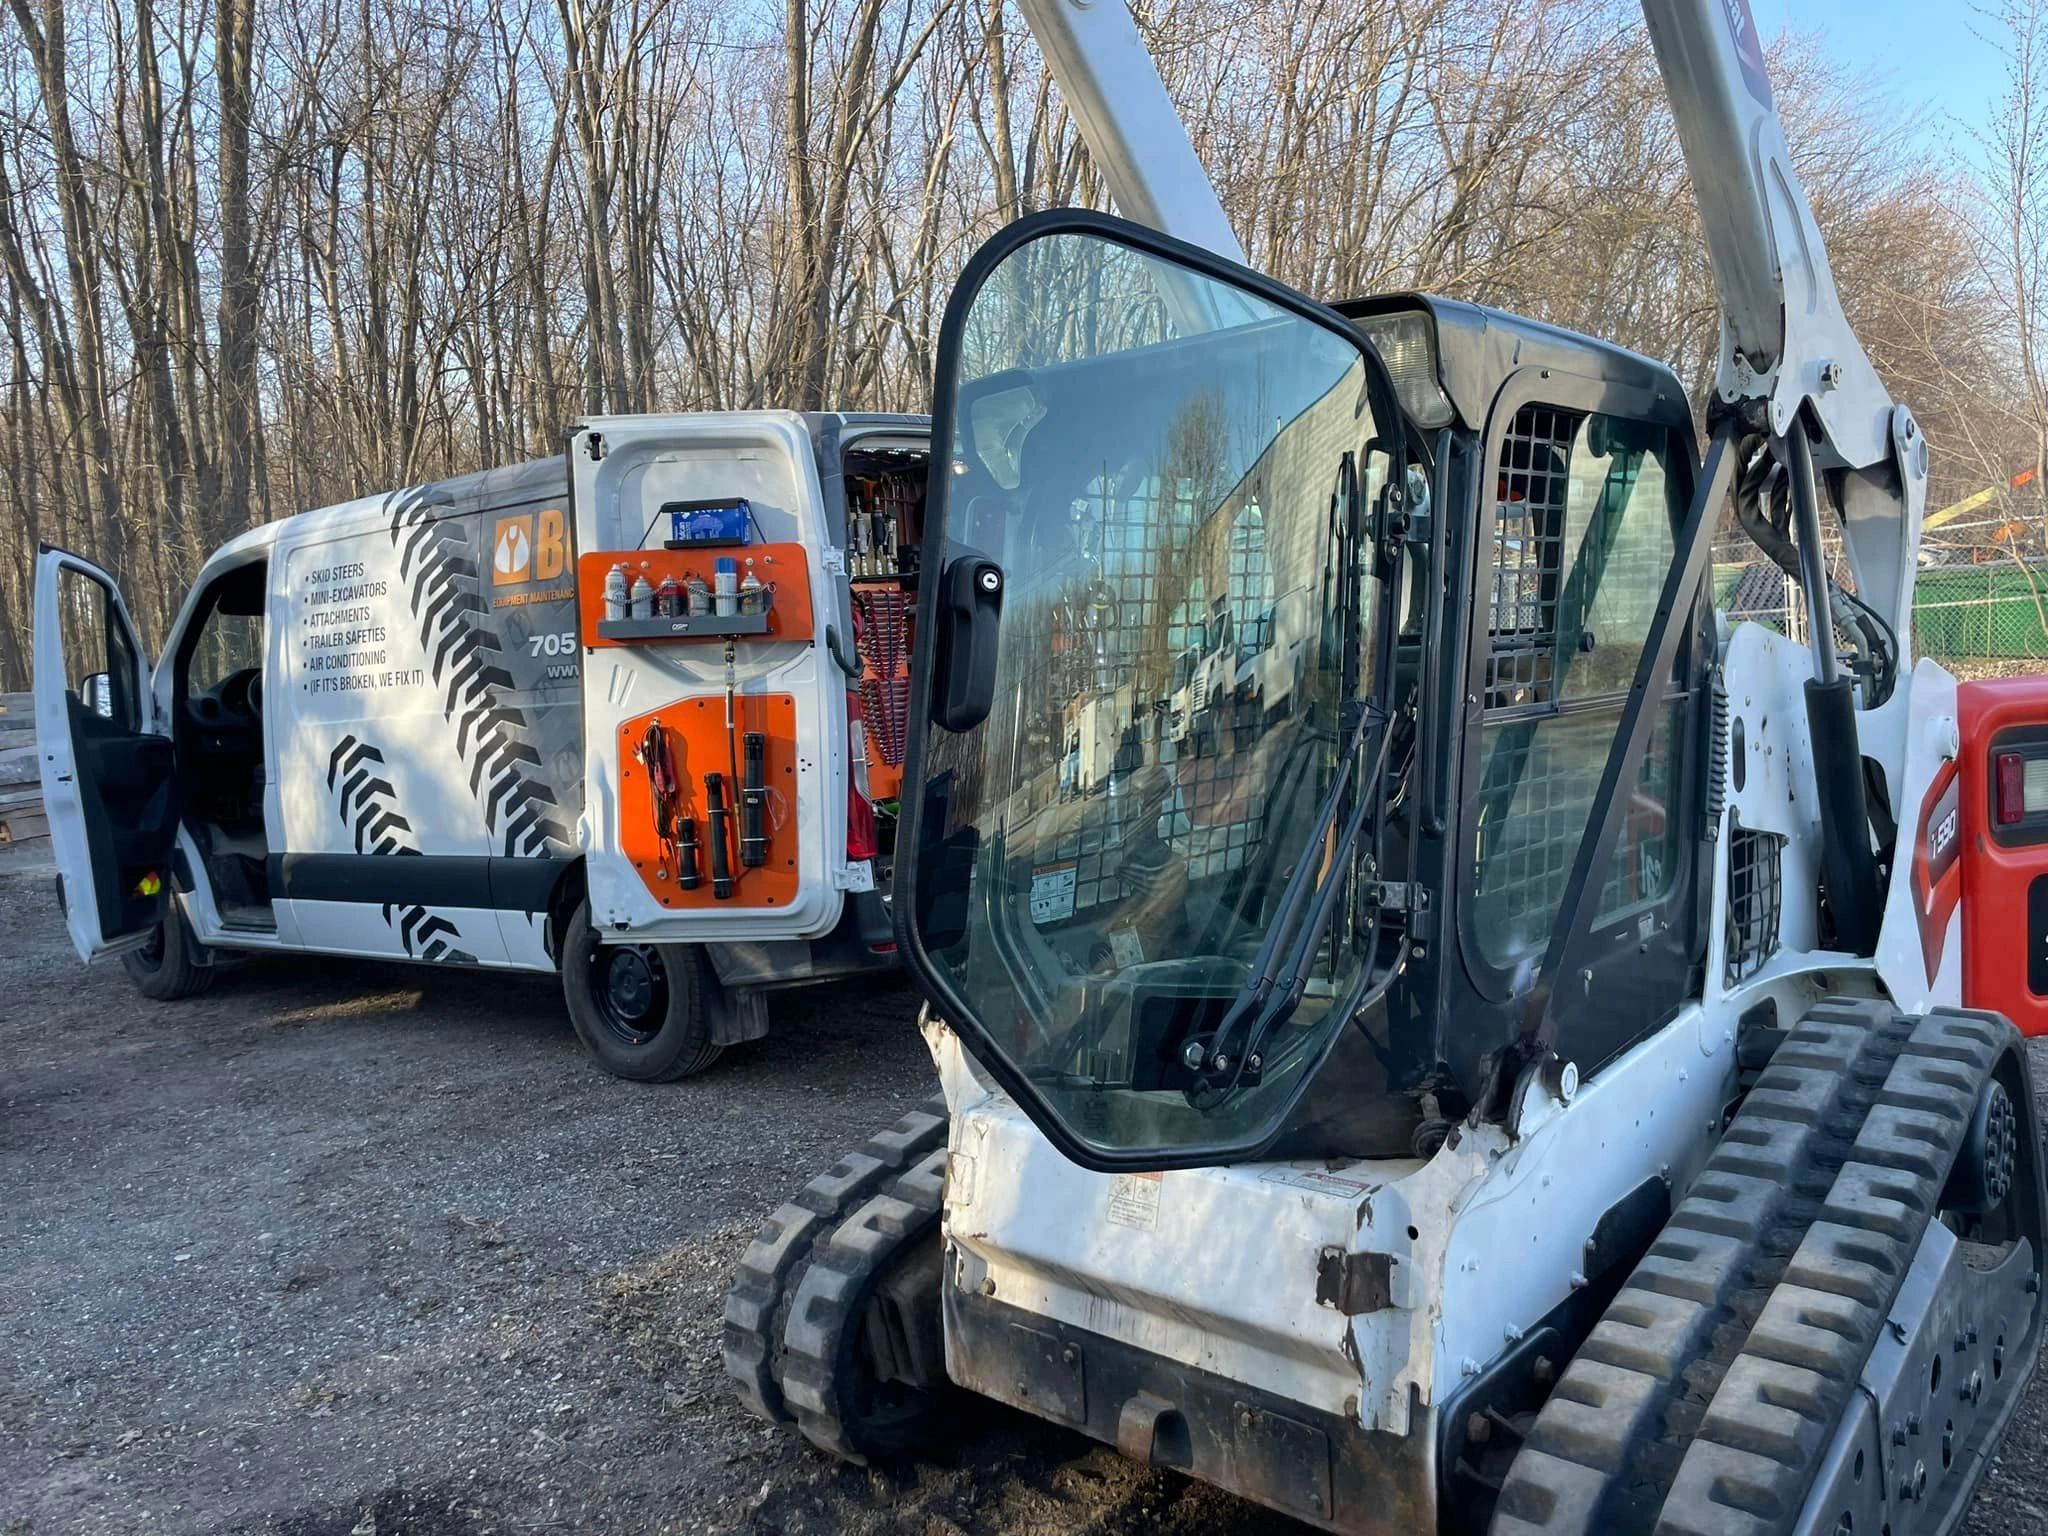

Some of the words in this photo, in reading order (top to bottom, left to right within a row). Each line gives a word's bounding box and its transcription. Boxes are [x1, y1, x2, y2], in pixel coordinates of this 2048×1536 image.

[536, 509, 574, 580] B
[311, 568, 331, 584] SKID
[332, 562, 365, 581] STEERS
[310, 581, 387, 606] MINI-EXCAVATORS
[310, 606, 370, 628] ATTACHMENTS
[310, 632, 344, 649] TRAILER
[345, 627, 386, 646] SAFETIES
[528, 632, 577, 657] 705
[310, 657, 324, 671] AIR
[325, 650, 386, 670] CONDITIONING
[310, 679, 321, 696] (IF
[322, 677, 338, 692] IT'S
[339, 673, 378, 691] BROKEN,
[379, 672, 393, 687] WE
[395, 670, 410, 685] FIX
[412, 669, 425, 688] IT)
